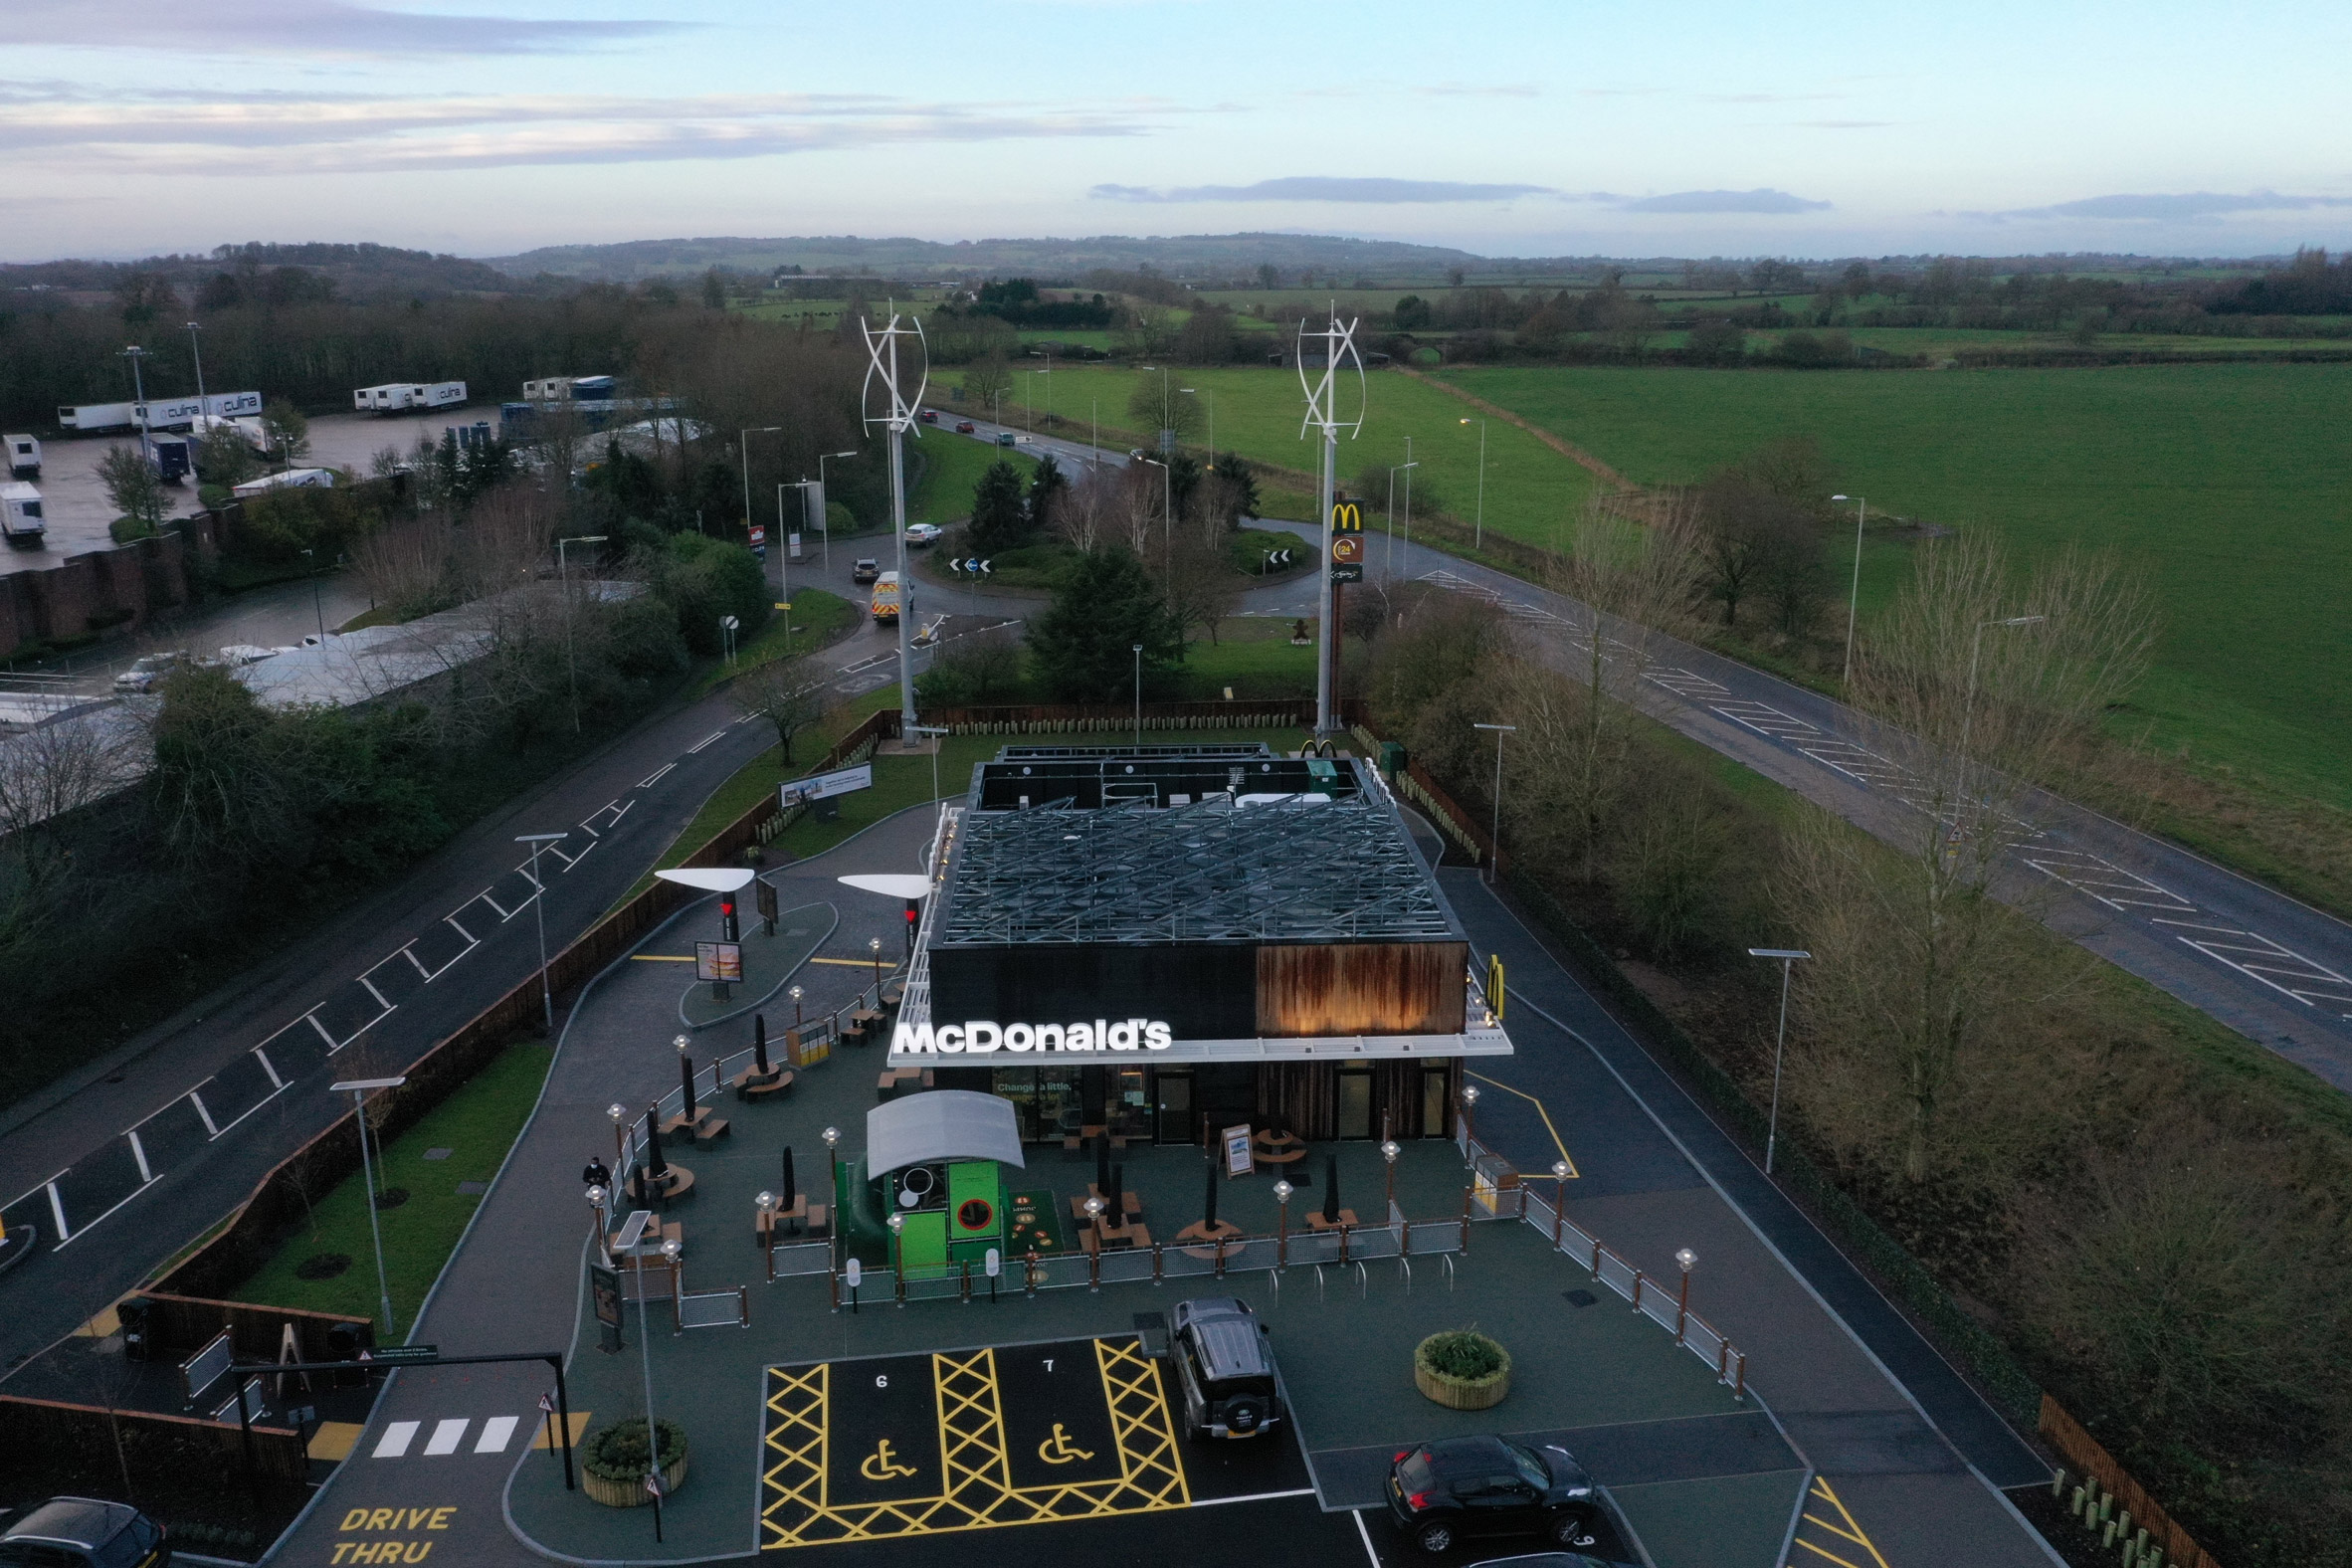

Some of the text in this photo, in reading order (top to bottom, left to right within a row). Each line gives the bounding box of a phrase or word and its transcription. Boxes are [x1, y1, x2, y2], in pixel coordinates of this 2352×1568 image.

[168, 404, 200, 418] culina
[224, 396, 258, 413] culina
[892, 1018, 1172, 1054] McDonald's
[997, 1083, 1035, 1092] Change
[1043, 1359, 1054, 1372] 7
[876, 1375, 887, 1388] 6
[338, 1506, 458, 1531] DRIVE
[330, 1541, 433, 1565] THRU
